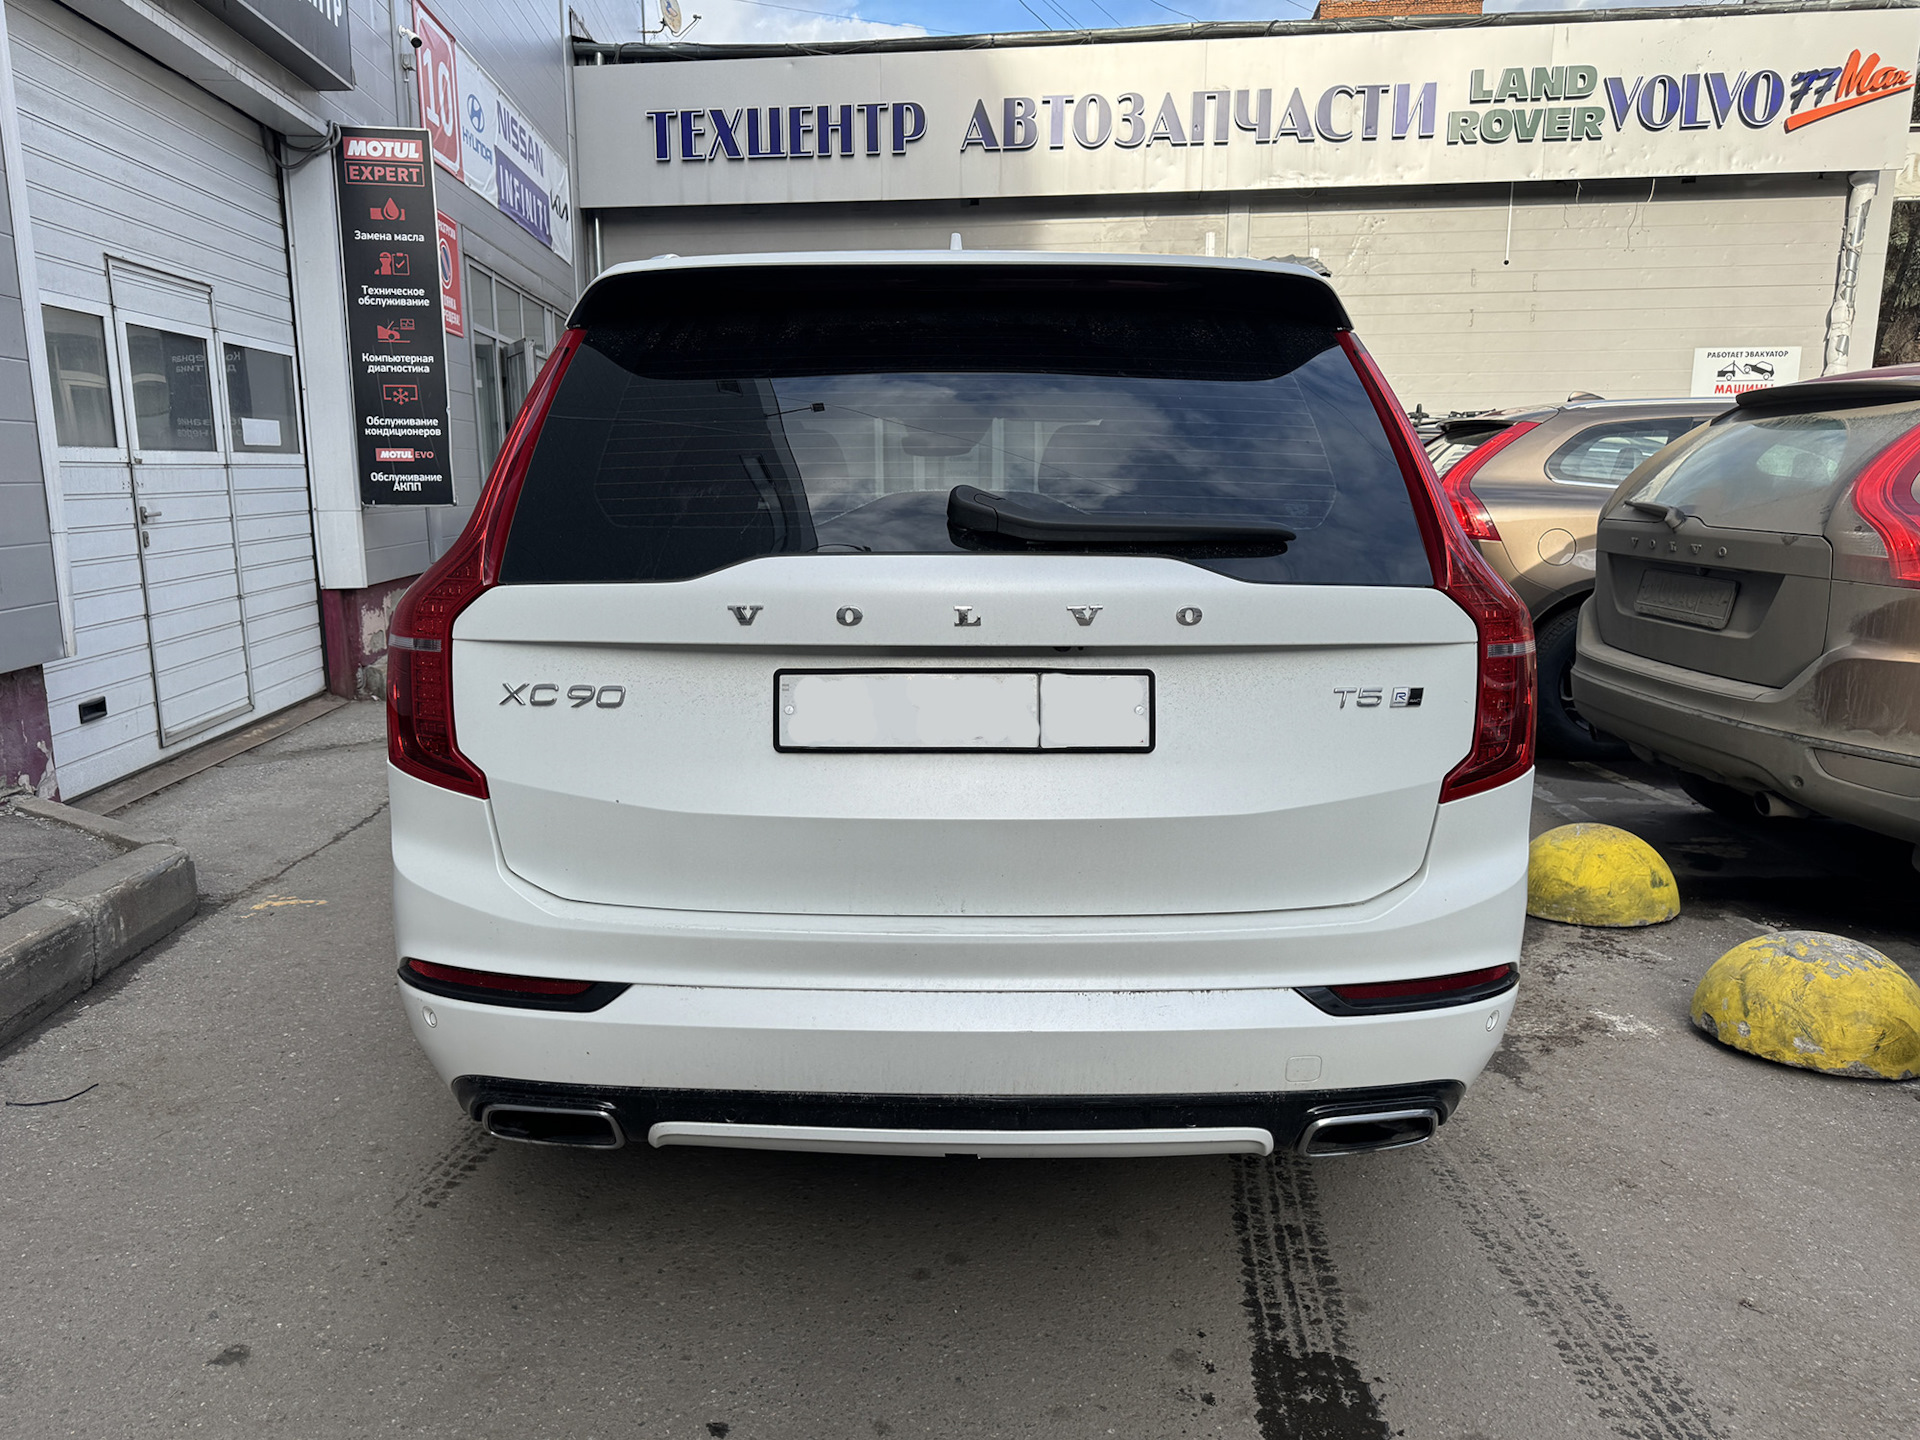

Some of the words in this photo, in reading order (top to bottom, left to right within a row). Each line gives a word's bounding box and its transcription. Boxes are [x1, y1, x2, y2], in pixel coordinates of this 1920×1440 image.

[423, 48, 453, 137] 10
[1470, 64, 1599, 104] LAND
[1603, 68, 1785, 132] VOLVO
[645, 101, 928, 162] ТЕХЦЕНТР
[959, 81, 1438, 153] АВТОЗАПЧАСТИ
[1446, 105, 1606, 146] ROVER
[462, 125, 493, 165] HYUNDA
[497, 99, 544, 178] NISSAN
[347, 140, 420, 159] MOTUL
[348, 165, 420, 183] EXPERT
[499, 164, 549, 236] INFINITI
[354, 230, 393, 242] Замена
[394, 232, 425, 242] масла
[361, 285, 425, 297] Техническое
[358, 296, 430, 308] обслуживание
[362, 352, 434, 364] Компьютерная
[1745, 350, 1789, 358] ЭВАКУАТОР
[367, 364, 430, 374] диагностика
[366, 415, 439, 427] Обслуживание
[364, 427, 442, 438] кондиционеров
[380, 451, 414, 459] MOTUL
[370, 471, 443, 483] Обслуживание
[393, 482, 422, 492] АКПП
[727, 604, 1203, 627] VOLVO
[1334, 686, 1383, 709] T5
